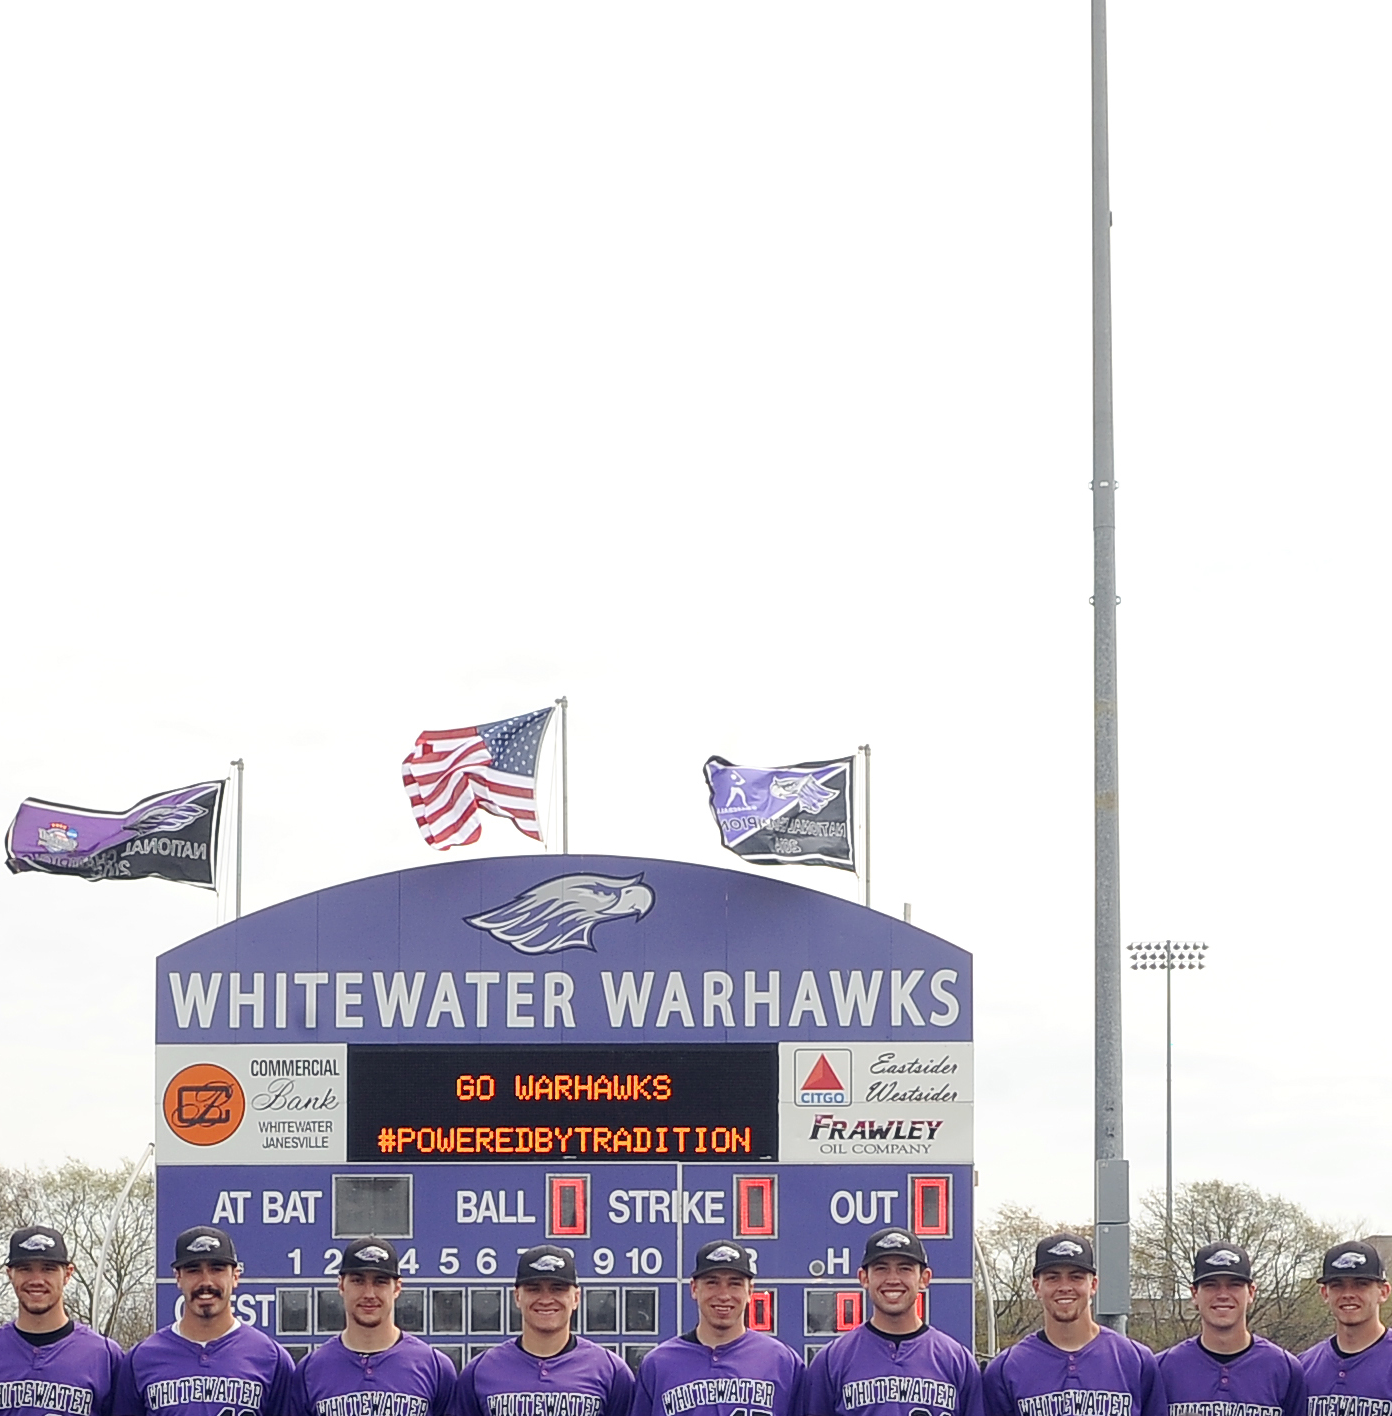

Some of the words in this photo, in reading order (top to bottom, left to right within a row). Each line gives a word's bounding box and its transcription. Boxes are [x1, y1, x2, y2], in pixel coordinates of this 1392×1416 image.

[168, 971, 576, 1029] WHITEWATER
[600, 969, 961, 1028] WARHAWKS
[250, 1059, 340, 1077] COMMERCIAL
[869, 1052, 958, 1074] Eastsider
[251, 1078, 340, 1111] Bank
[455, 1074, 496, 1101] GO
[514, 1074, 673, 1101] WARHAWKS
[800, 1092, 845, 1104] CITGO
[865, 1081, 958, 1102] Westsider
[259, 1121, 333, 1133] WHITEWATER
[377, 1126, 752, 1154] #POWEREDBYTRADITION
[808, 1114, 944, 1140] FRAWLEY
[262, 1136, 329, 1149] JANESVILLE
[820, 1144, 847, 1154] OIL
[852, 1144, 932, 1154] COMPANY
[211, 1191, 251, 1224] AT
[262, 1190, 322, 1224] BAT
[456, 1190, 536, 1223] BALL
[608, 1190, 725, 1224] STRIKE
[830, 1190, 898, 1224] OUT
[287, 1248, 302, 1274] 1
[324, 1248, 343, 1274] 2
[399, 1248, 419, 1274] 4
[439, 1248, 460, 1275] 5
[476, 1248, 497, 1275] 6
[593, 1247, 614, 1275] 9
[625, 1247, 663, 1275] 10
[827, 1248, 850, 1275] H
[147, 1376, 263, 1410] WHITEWATER
[842, 1376, 956, 1410] WHITEWATER
